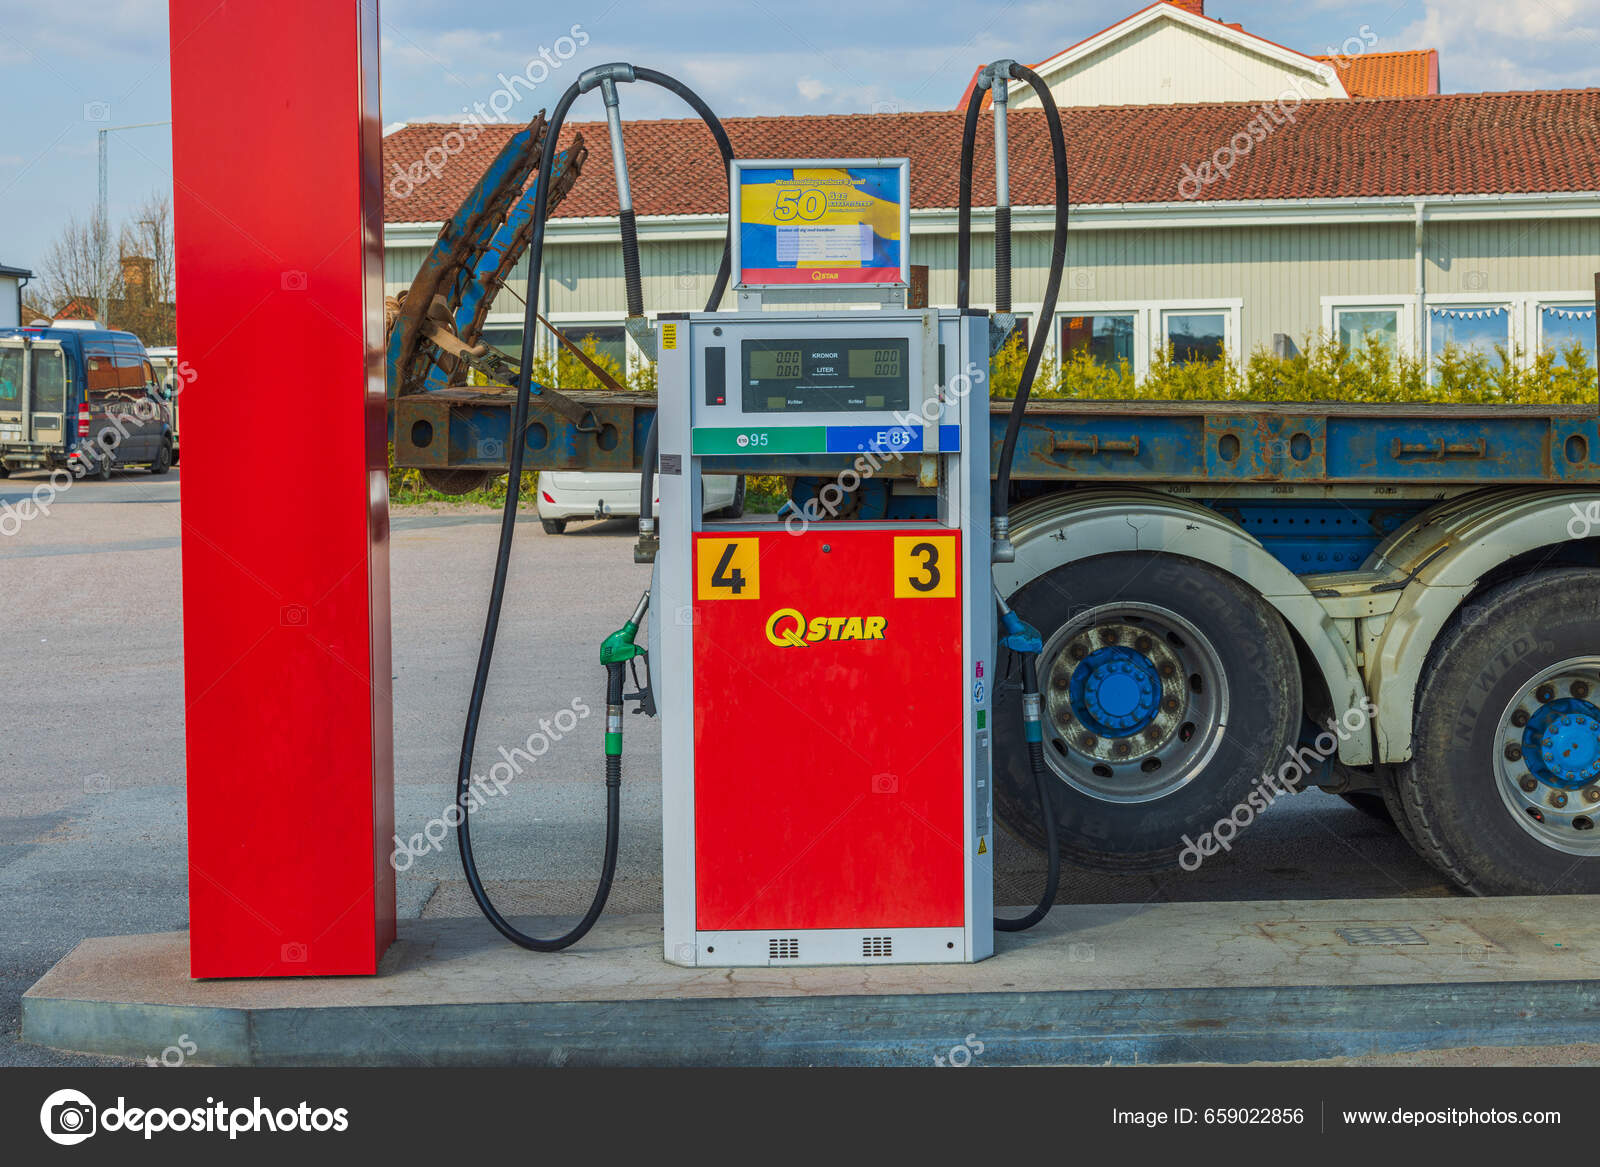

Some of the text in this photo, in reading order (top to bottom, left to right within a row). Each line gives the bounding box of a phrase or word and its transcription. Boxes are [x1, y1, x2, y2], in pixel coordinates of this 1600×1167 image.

[774, 188, 827, 221] 50
[811, 271, 839, 281] QSTAR
[750, 433, 768, 447] 95
[876, 432, 910, 445] E 85
[711, 544, 745, 594] 4
[909, 543, 941, 592] 3
[766, 608, 888, 648] QSTAR
